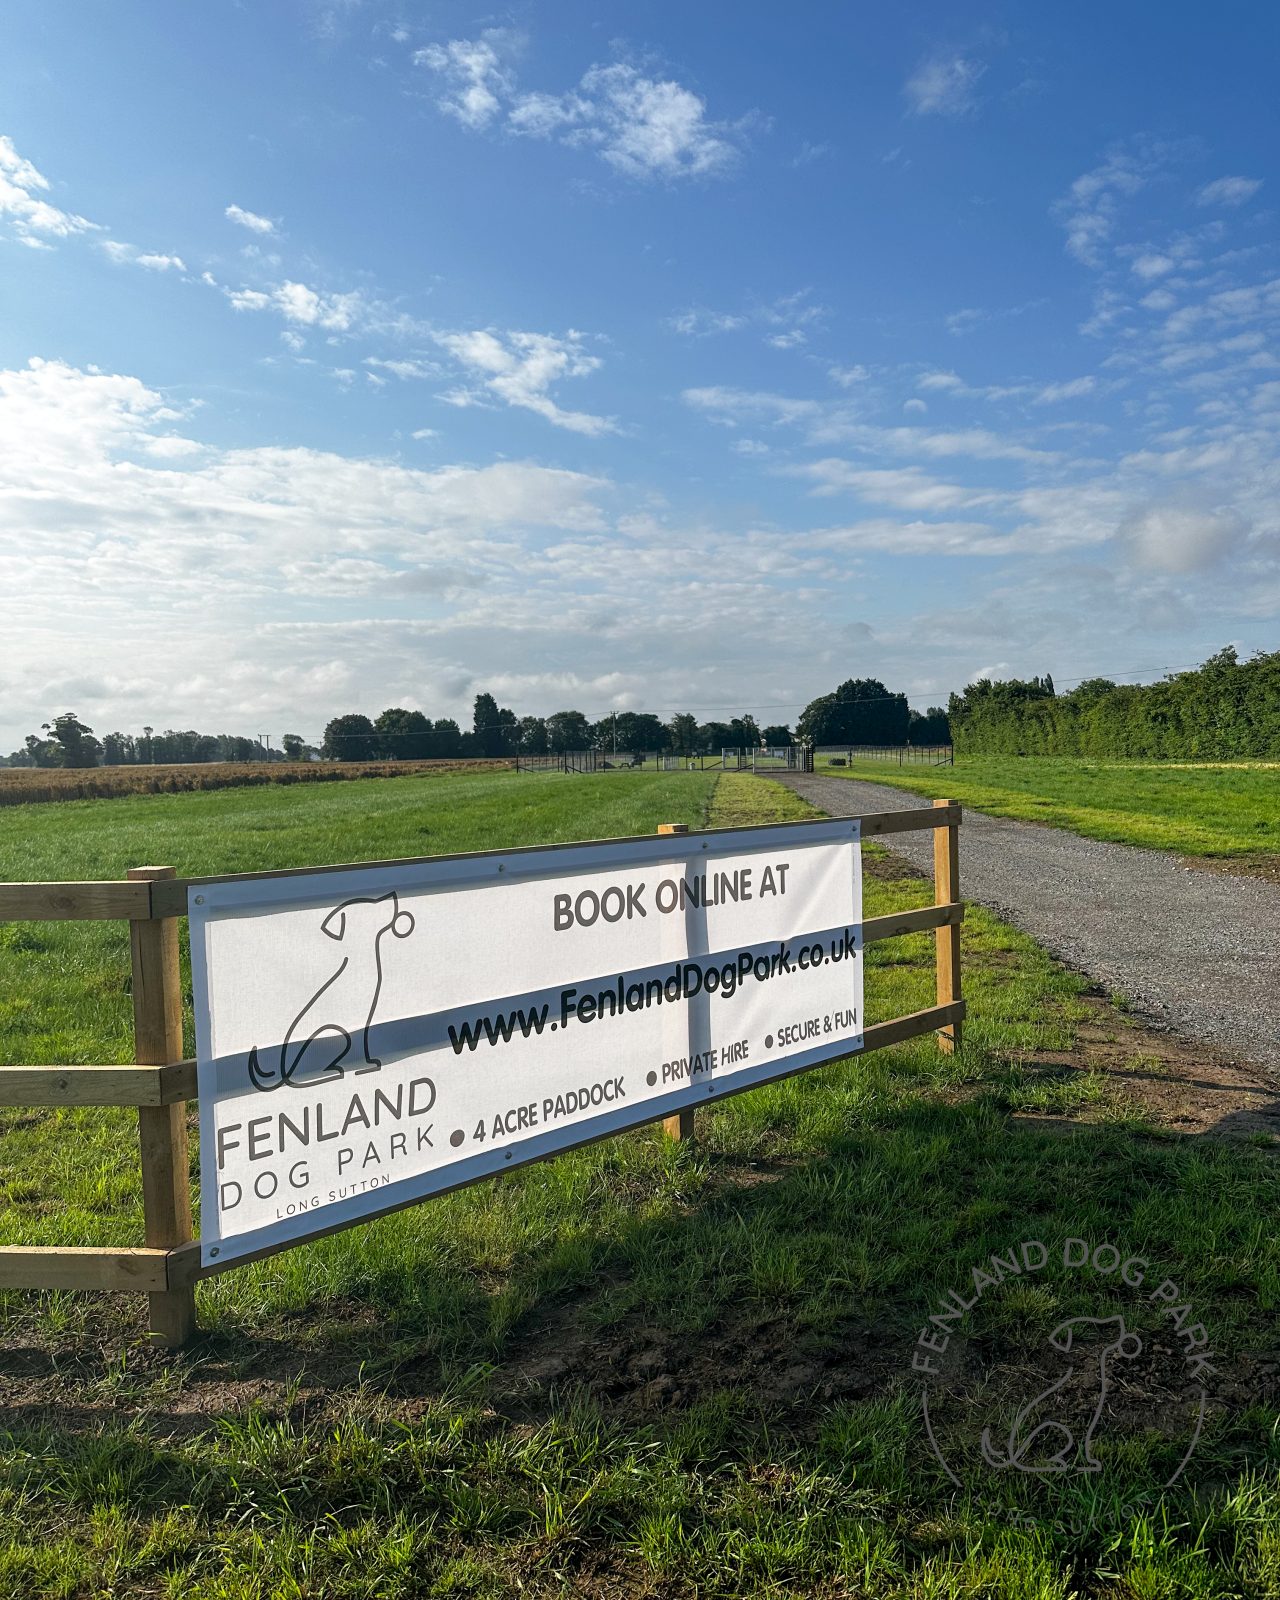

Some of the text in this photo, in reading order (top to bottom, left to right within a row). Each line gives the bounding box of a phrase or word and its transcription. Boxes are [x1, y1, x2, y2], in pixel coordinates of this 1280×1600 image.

[553, 863, 790, 931] BOOK ONLINE AT
[447, 928, 857, 1055] www.FenlandDogPark.co.uk
[472, 1008, 857, 1143] 4 ACRE PADDOCK PRIVATE HIRE SECURE & FUN
[217, 1077, 437, 1170] FENLAND
[219, 1123, 435, 1212] DOG PARK
[275, 1173, 391, 1219] LONG SUTTON
